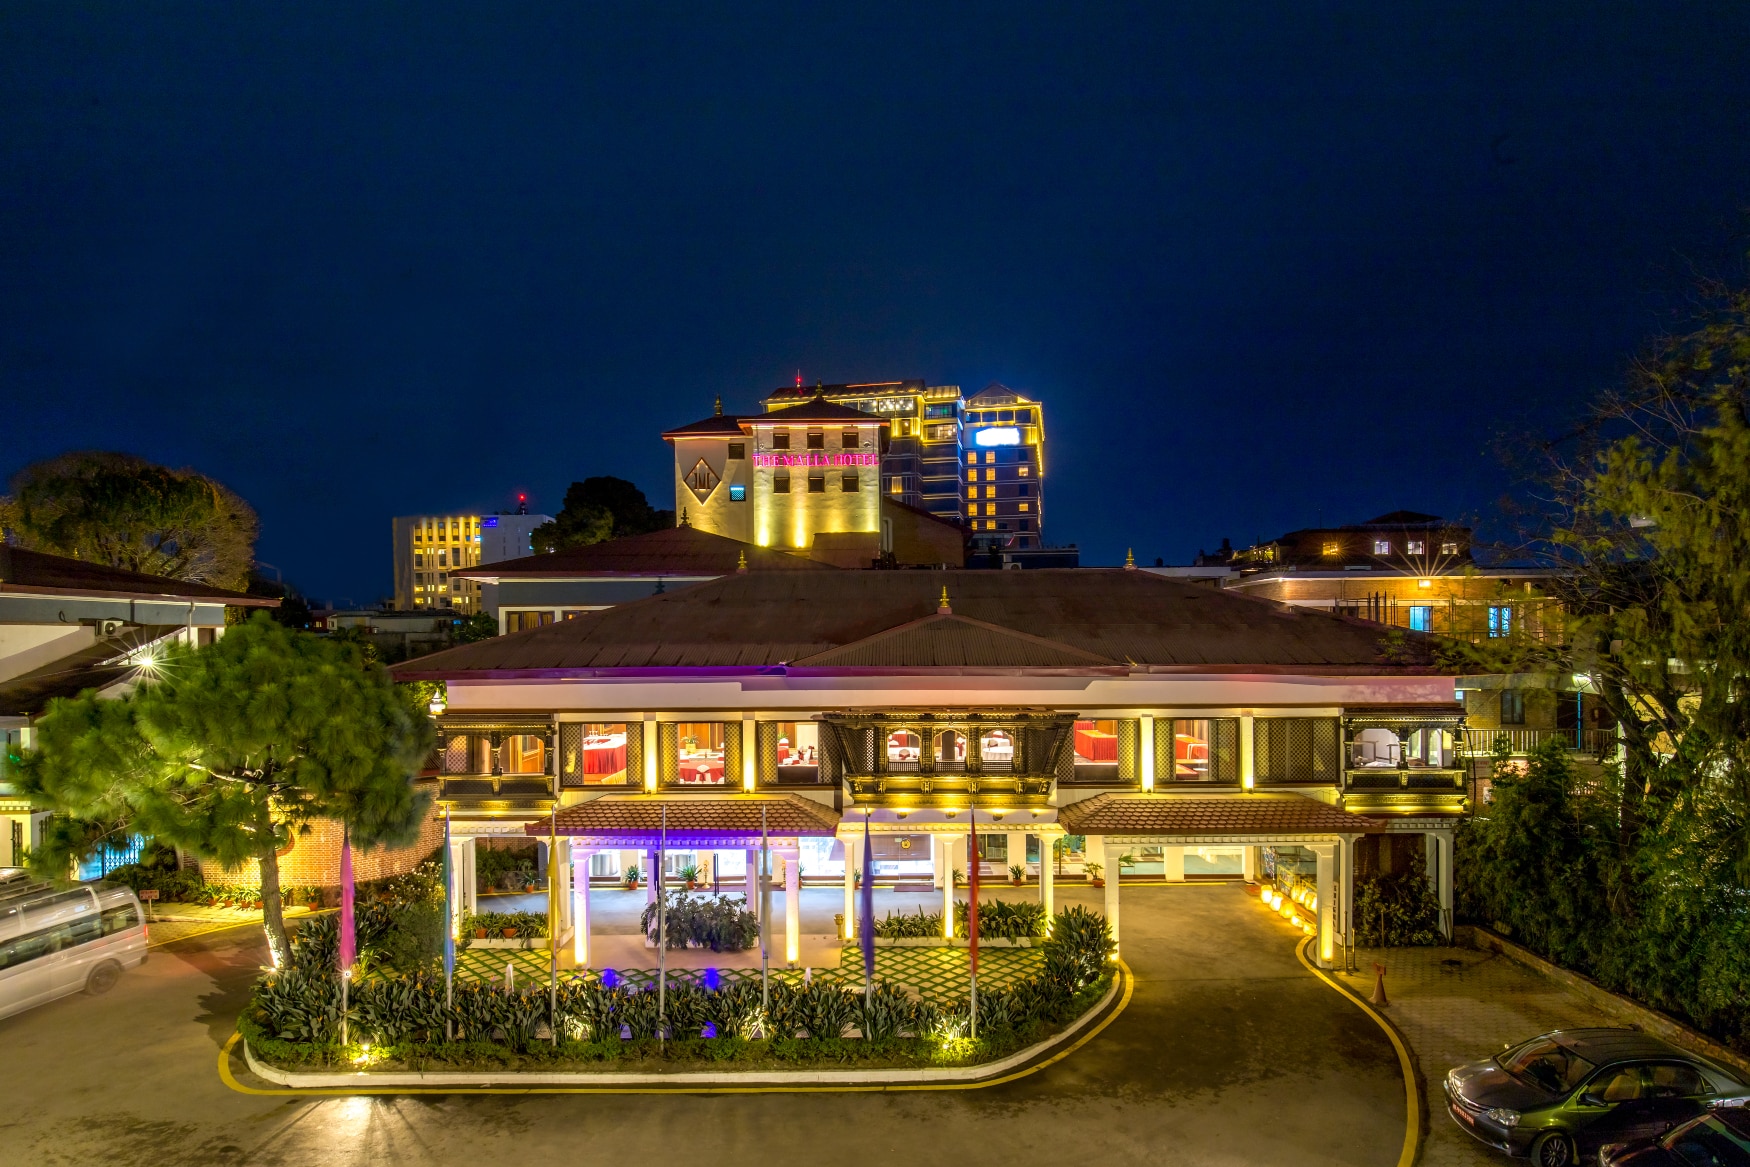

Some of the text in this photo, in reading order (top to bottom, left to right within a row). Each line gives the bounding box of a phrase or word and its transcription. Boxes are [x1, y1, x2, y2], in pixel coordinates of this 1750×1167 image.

[752, 454, 880, 467] THE MALLA HOTEL
